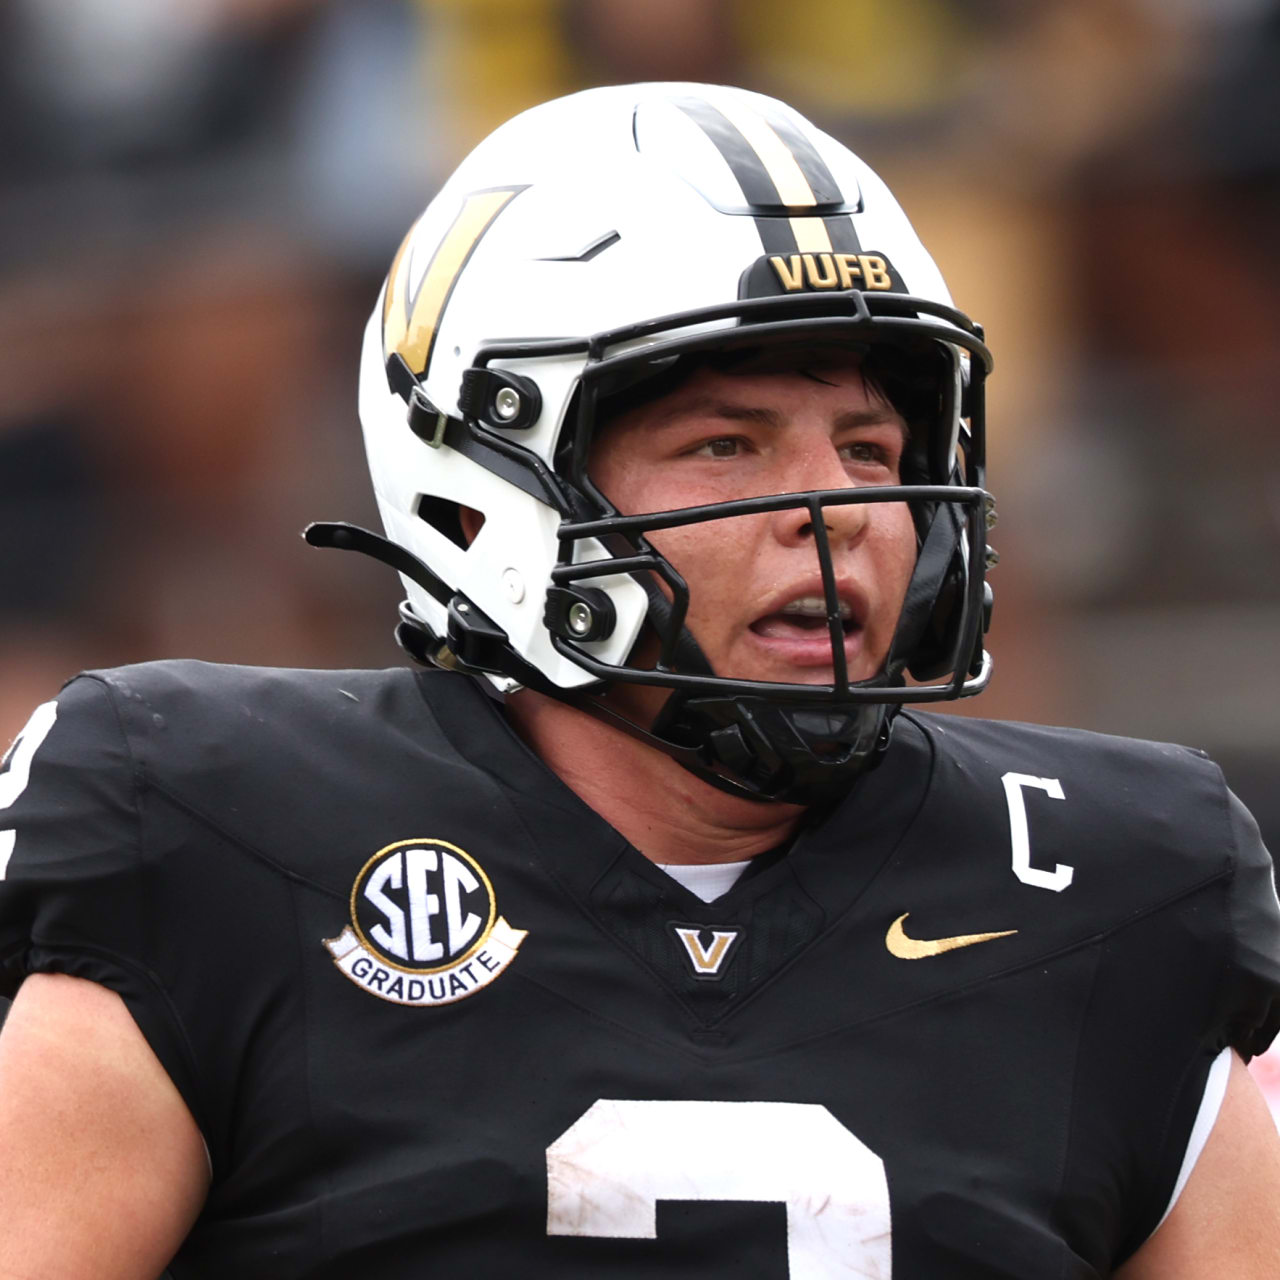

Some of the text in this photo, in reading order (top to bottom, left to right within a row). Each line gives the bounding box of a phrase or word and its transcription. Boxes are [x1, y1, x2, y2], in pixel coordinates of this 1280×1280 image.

[769, 253, 892, 291] VUFB
[1001, 771, 1074, 892] C
[364, 849, 482, 962] SEC
[351, 950, 501, 1001] GRADUATE
[674, 927, 738, 973] V
